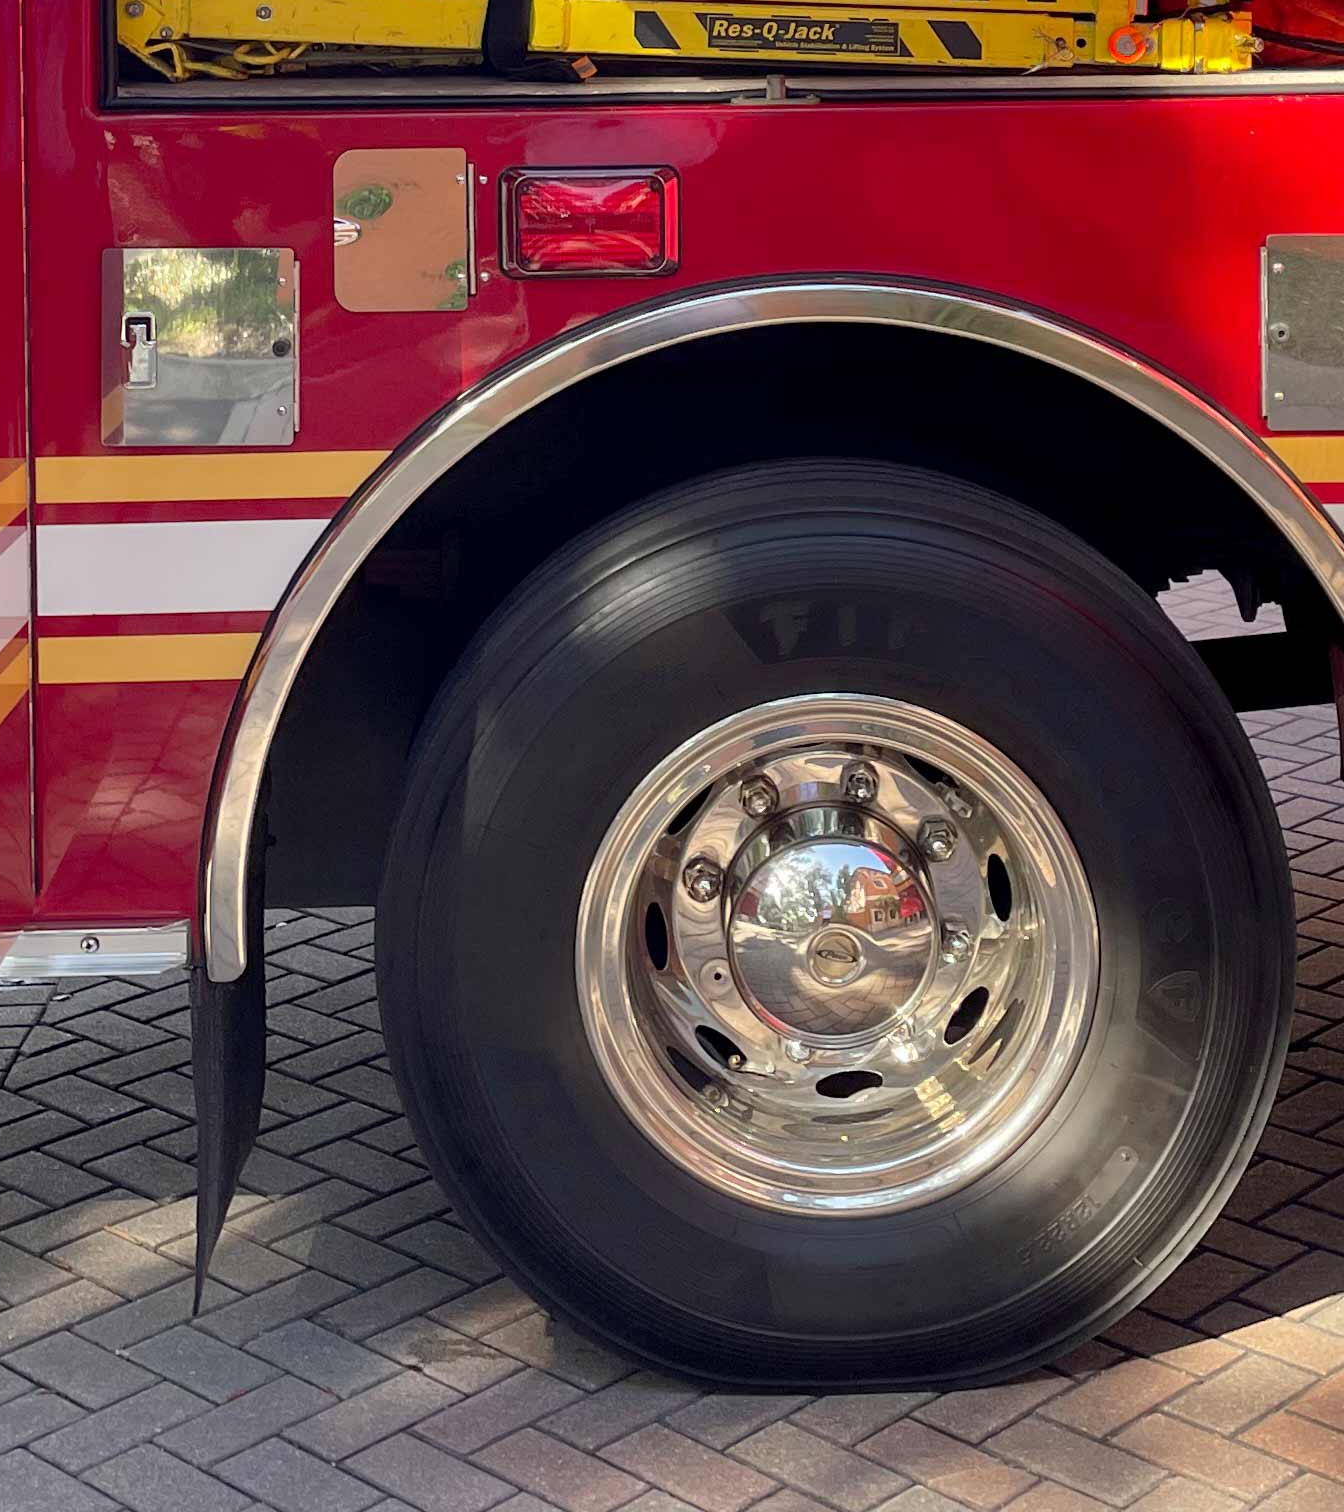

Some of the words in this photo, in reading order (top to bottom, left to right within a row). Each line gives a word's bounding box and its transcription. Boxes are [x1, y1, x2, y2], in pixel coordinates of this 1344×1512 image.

[712, 19, 836, 41] Res-Q-Jack
[849, 43, 869, 51] Lifting
[871, 44, 894, 52] System
